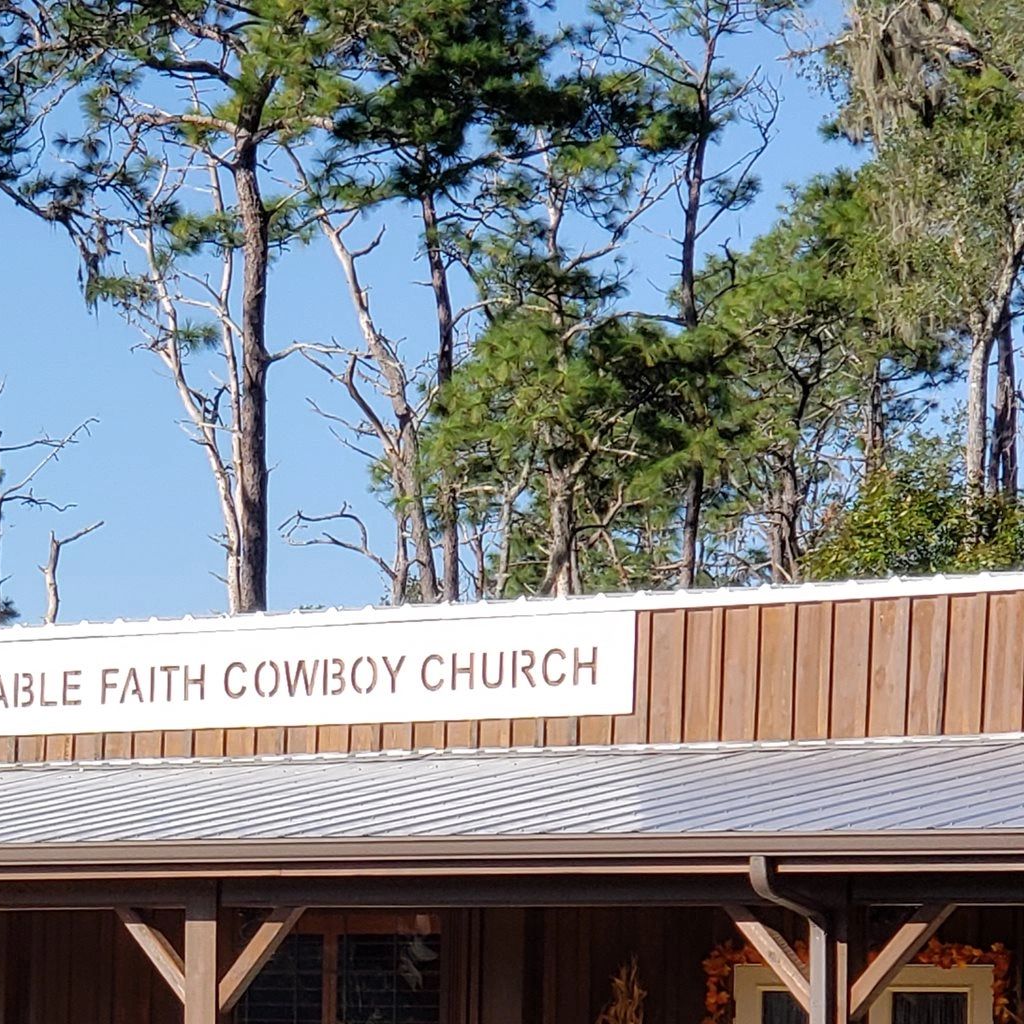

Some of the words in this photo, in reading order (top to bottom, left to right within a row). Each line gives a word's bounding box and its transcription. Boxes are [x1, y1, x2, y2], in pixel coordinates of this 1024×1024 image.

[101, 664, 206, 704] FAITH
[223, 655, 406, 700] COWBOY
[420, 646, 598, 692] CHURCH
